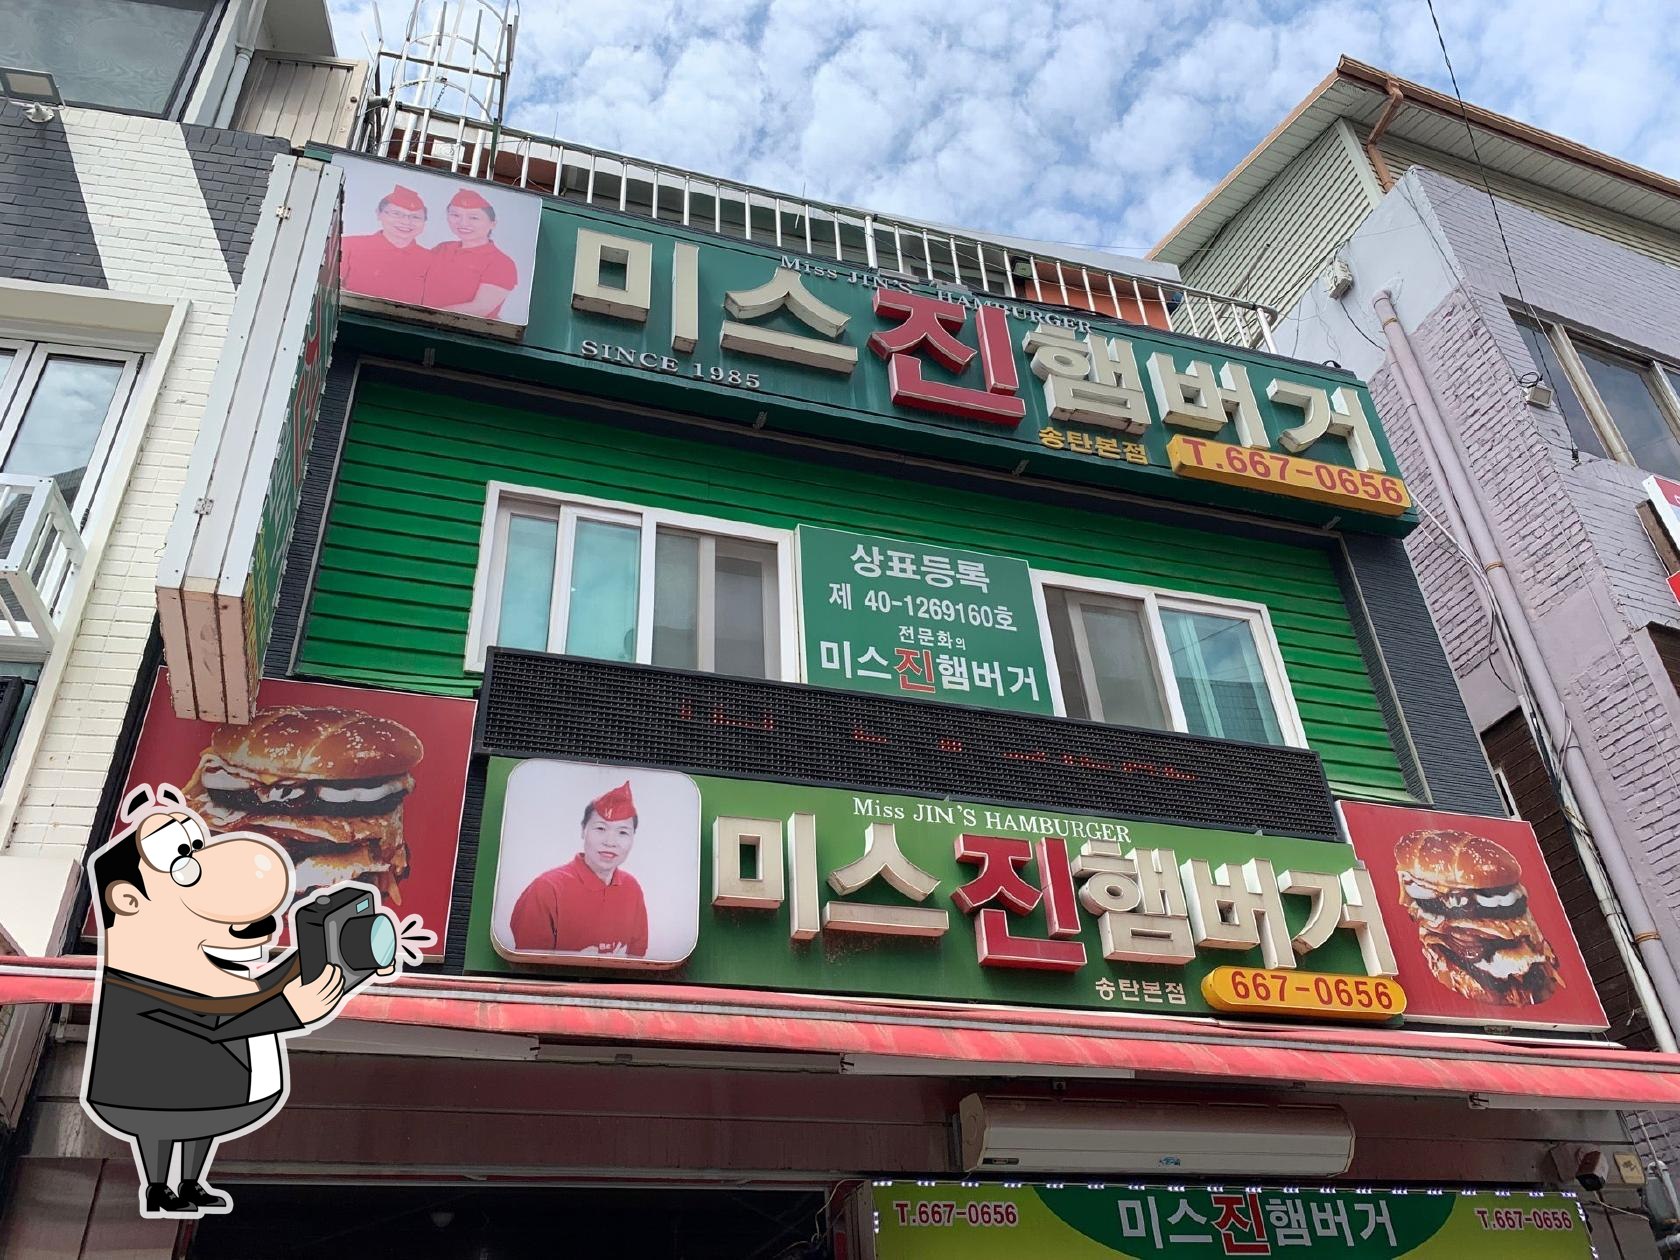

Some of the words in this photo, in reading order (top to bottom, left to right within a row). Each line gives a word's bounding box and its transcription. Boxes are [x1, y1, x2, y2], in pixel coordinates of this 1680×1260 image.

[780, 255, 838, 279] Miss
[848, 271, 913, 295] JIN'S
[936, 289, 1092, 333] HAMURGER
[571, 227, 1386, 473] 미스진햄버거
[580, 340, 680, 373] SINCE
[693, 361, 762, 390] 1985
[1038, 427, 1150, 466] 송탄본점
[1181, 438, 1404, 505] T.667-0656
[850, 544, 990, 594] 상표등록
[828, 582, 853, 611] 제
[864, 590, 1018, 632] 40-1269160호
[819, 640, 1040, 701] 미스진햄버거
[852, 797, 905, 820] Miss
[913, 804, 977, 827] JIN'S
[984, 811, 1132, 844] HAMBURGER
[711, 812, 1400, 976] 미스진햄버거
[1095, 976, 1188, 1006] 송탄본점
[1231, 969, 1394, 1010] 667-0656
[894, 1201, 1018, 1227] T.667-0656
[1117, 1191, 1398, 1256] 미스진햄버거
[1475, 1208, 1573, 1230] T.667-0656
